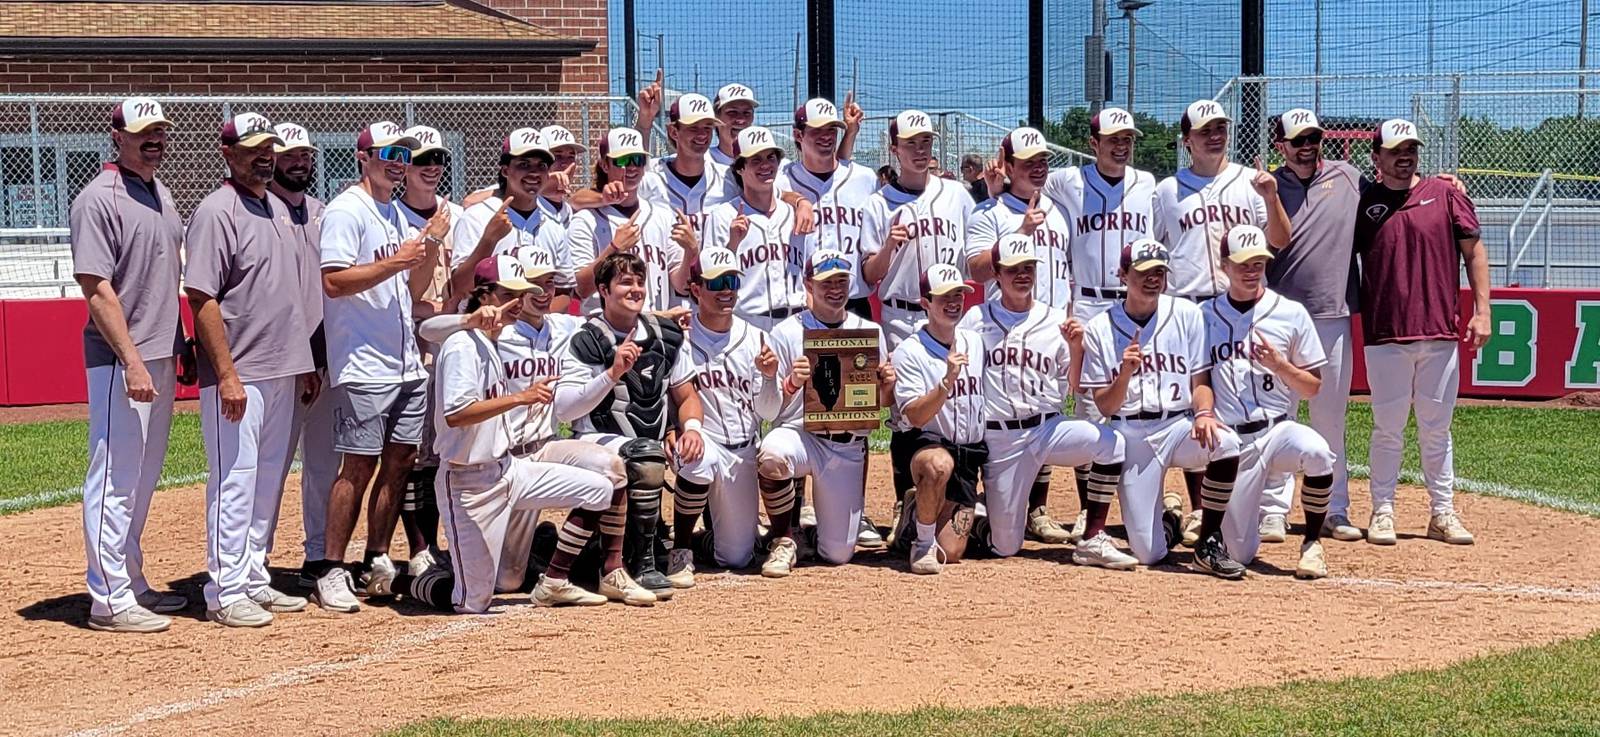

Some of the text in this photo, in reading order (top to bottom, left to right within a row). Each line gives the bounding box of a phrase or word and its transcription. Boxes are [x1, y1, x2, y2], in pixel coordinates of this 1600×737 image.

[1077, 211, 1148, 236] MORRIS
[1179, 204, 1250, 232] MORRIS
[903, 217, 957, 243] ORRIS
[1034, 229, 1068, 252] RRI
[374, 243, 400, 262] MOR
[630, 245, 667, 271] RRIS
[740, 233, 804, 271] MORRIS
[1056, 260, 1067, 280] 12
[813, 339, 871, 347] REGIONAL
[504, 356, 564, 380] MORRI
[947, 376, 982, 400] ORRI
[1170, 383, 1182, 402] 2
[1262, 373, 1275, 392] 8
[808, 411, 876, 420] CHAMPIONS
